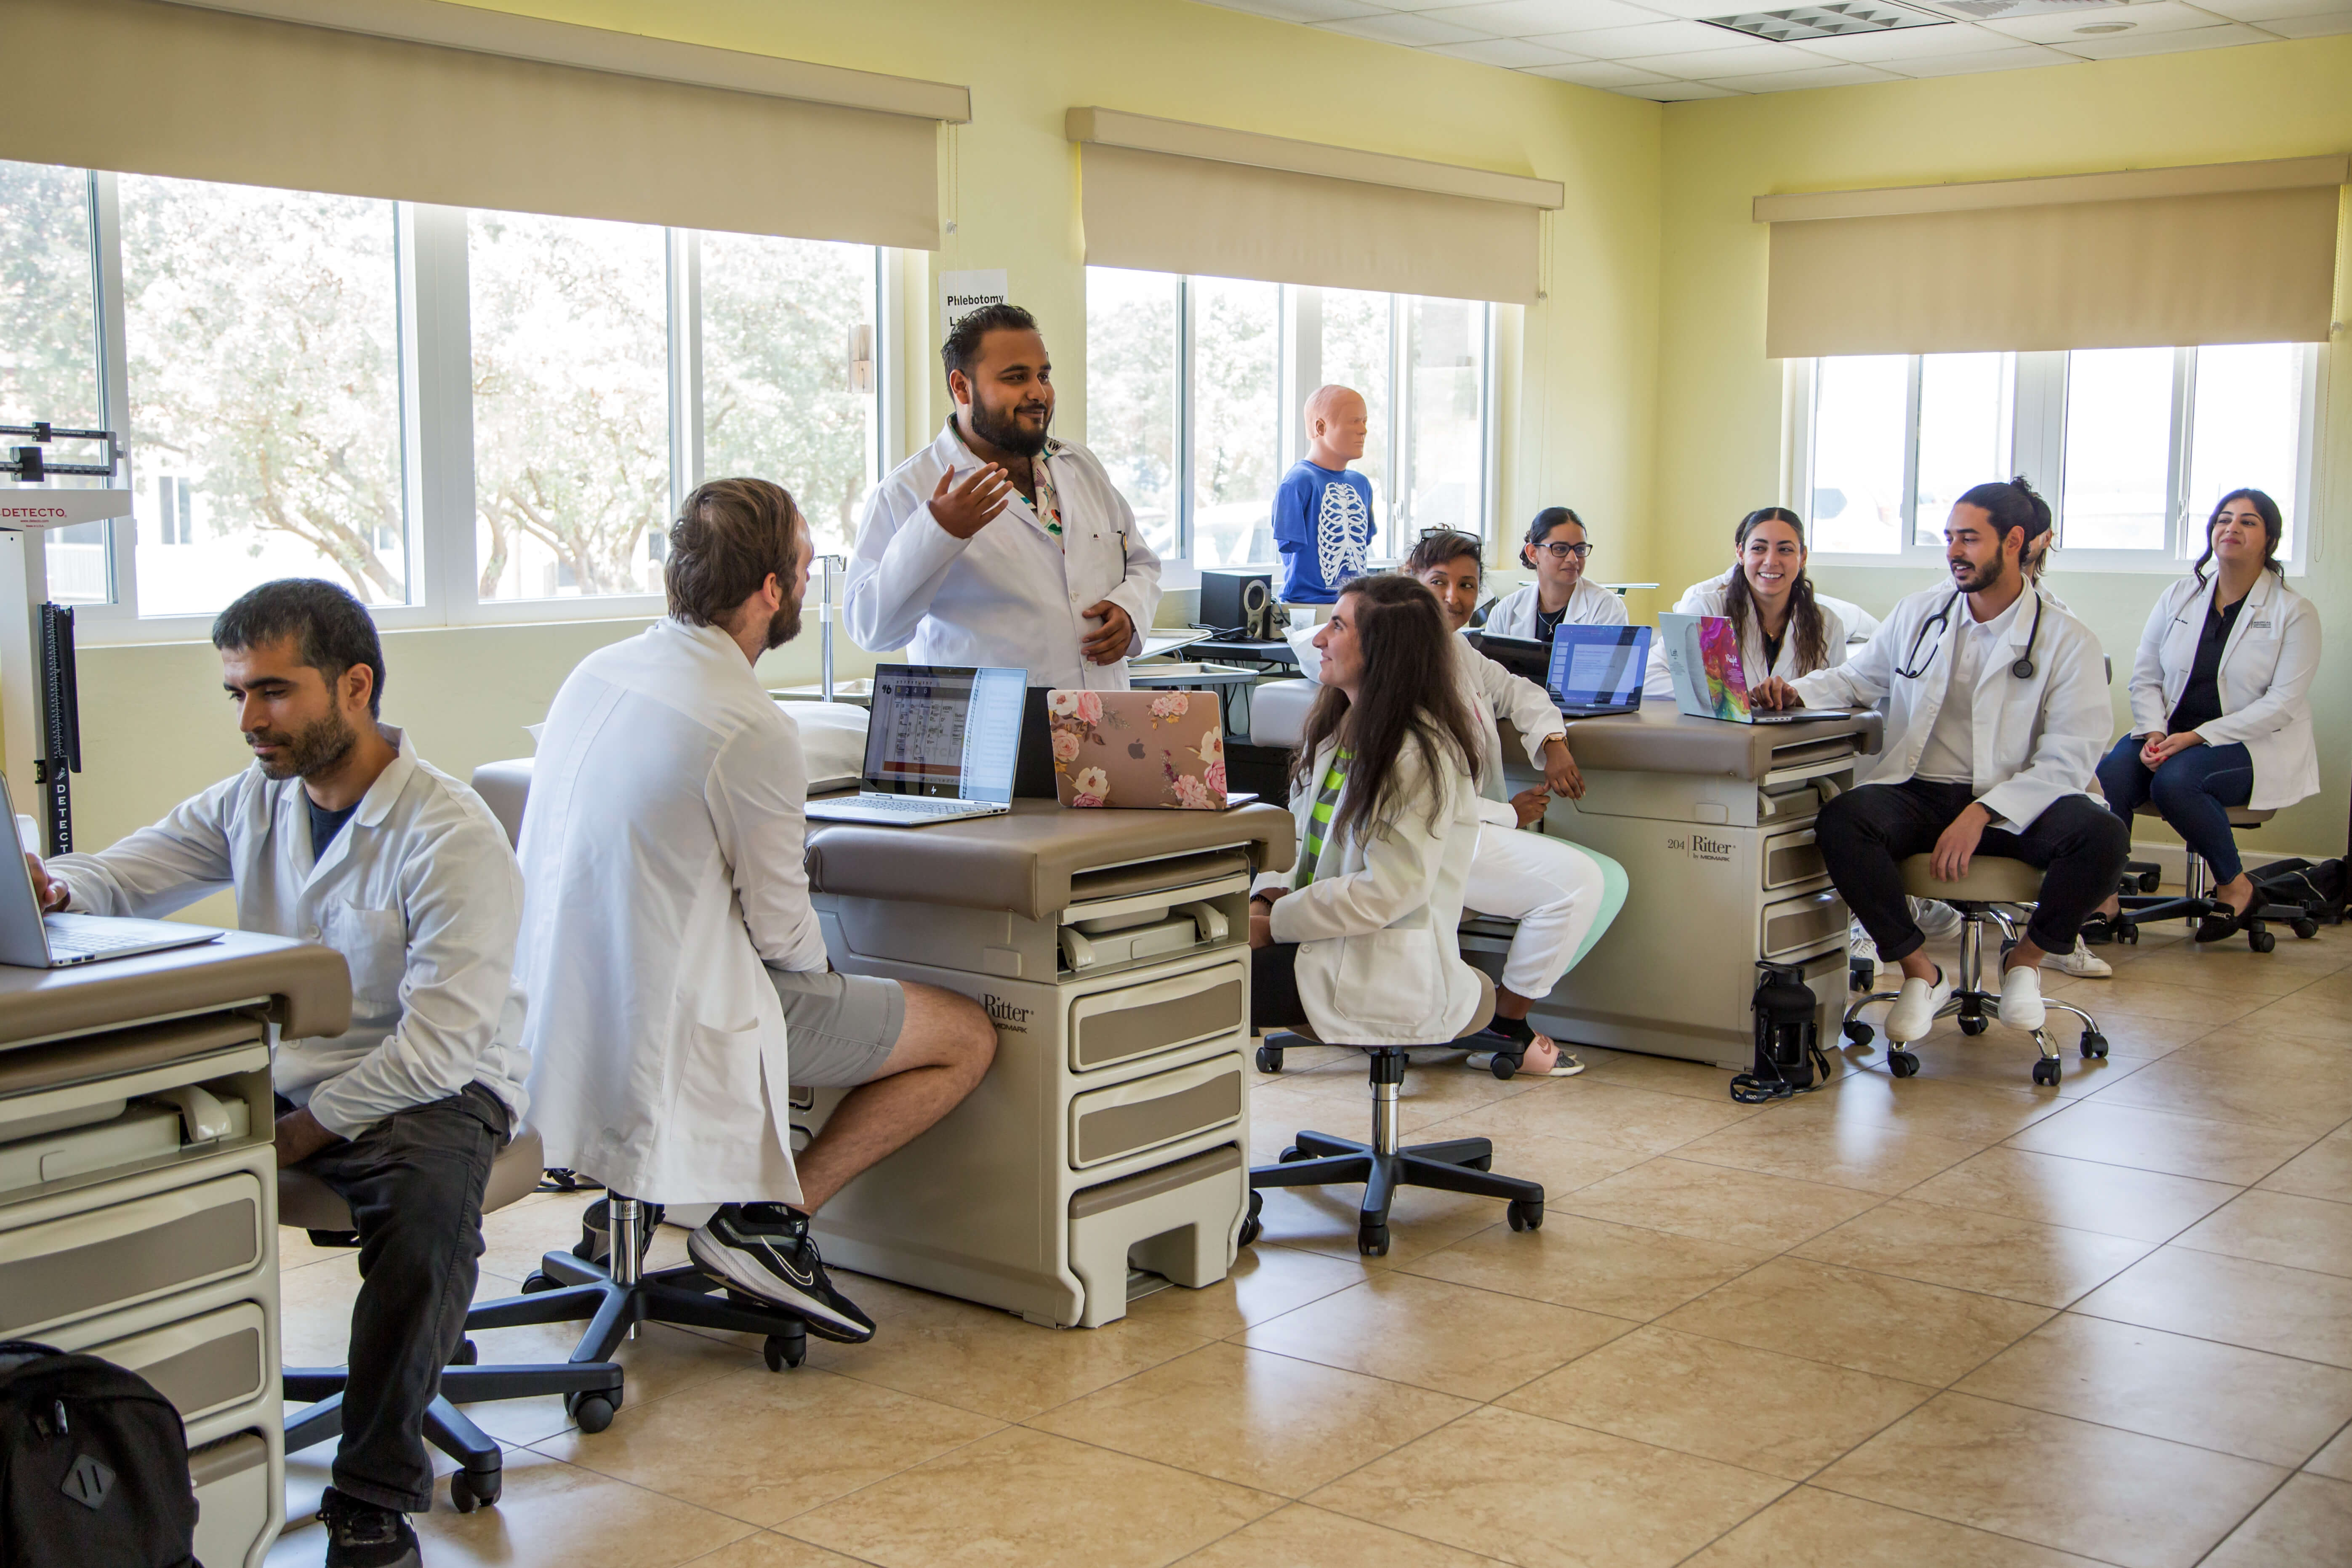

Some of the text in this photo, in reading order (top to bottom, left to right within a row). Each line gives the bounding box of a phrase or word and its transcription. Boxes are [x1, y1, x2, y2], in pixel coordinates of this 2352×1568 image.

[947, 294, 1004, 306] Phlebotomy
[2, 508, 64, 517] DETECTO
[1667, 835, 1731, 854] 204 Ritter
[983, 993, 1029, 1023] Ritter
